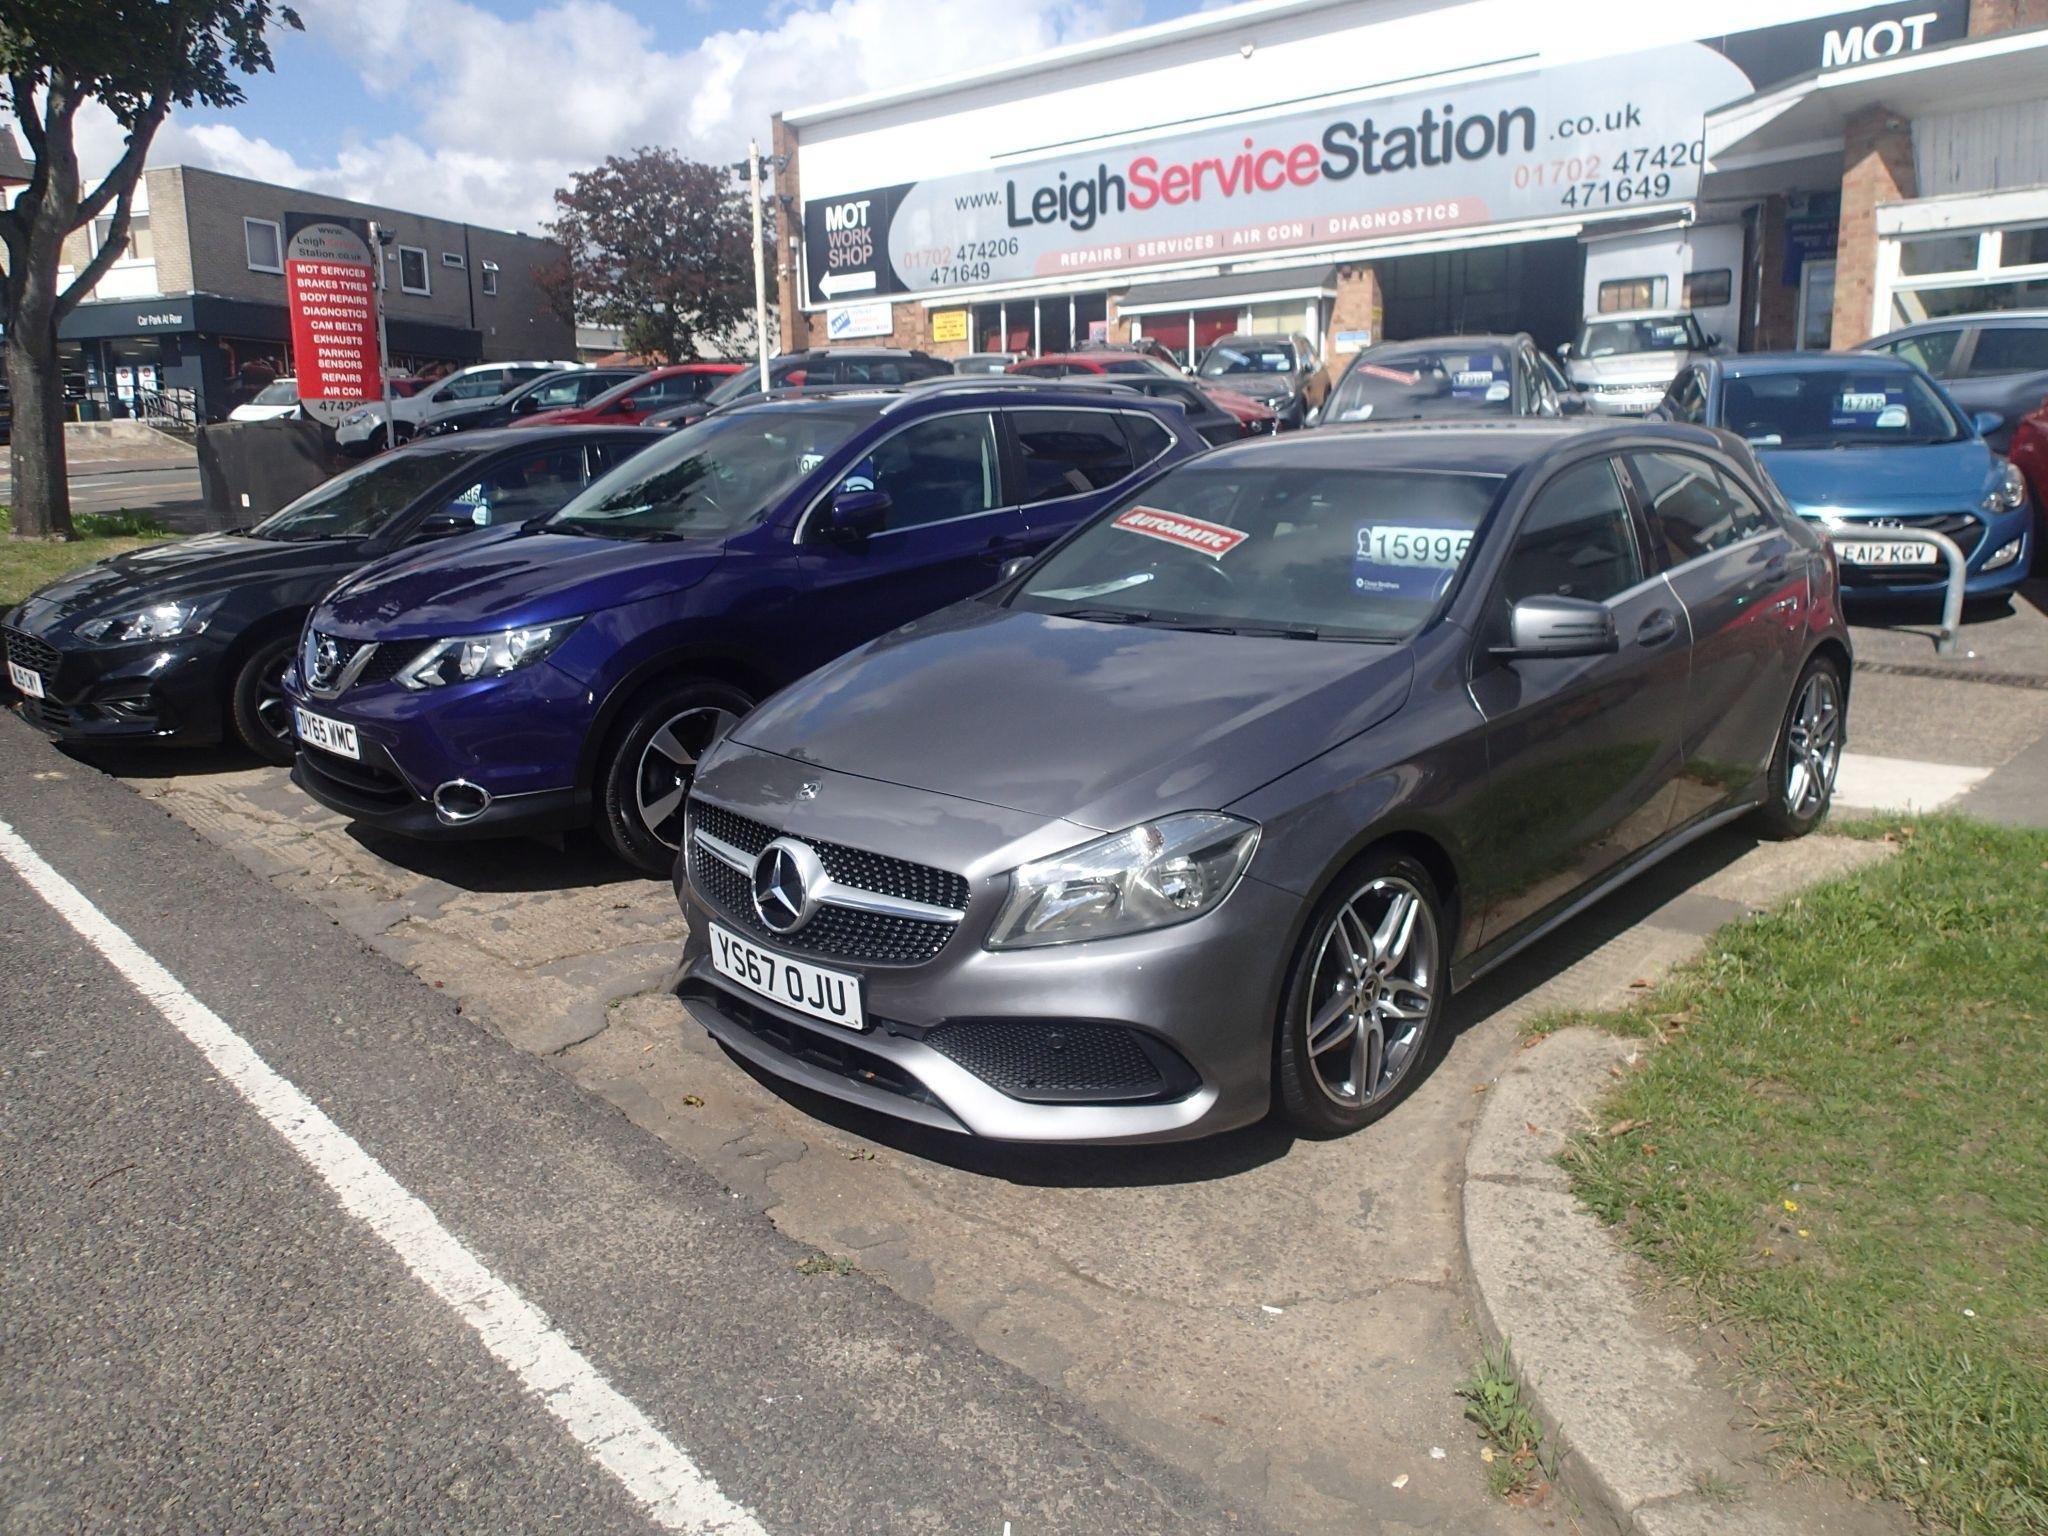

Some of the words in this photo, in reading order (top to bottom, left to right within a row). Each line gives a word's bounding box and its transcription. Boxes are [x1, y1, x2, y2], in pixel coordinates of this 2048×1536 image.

[1822, 12, 1937, 67] MOT
[1514, 155, 1601, 189] 01702
[1561, 173, 1671, 209] 471649
[825, 201, 870, 232] MOT
[828, 227, 872, 248] WORK
[1060, 247, 1122, 267] REPAIRS
[1137, 235, 1214, 257] SERVICES
[1232, 228, 1261, 245] AIR
[1267, 223, 1303, 241] CON
[1328, 203, 1460, 234] DIAGNOSTICS
[829, 245, 873, 268] SHOP
[904, 247, 951, 269] 01702
[957, 238, 1019, 262] 474206
[297, 264, 318, 273] MOT
[321, 265, 365, 278] SERVICES
[931, 262, 990, 284] 471649
[297, 279, 337, 289] BRAKES
[340, 281, 367, 291] TYRES
[300, 292, 327, 302] BODY
[329, 294, 367, 305] REPAIRS
[303, 306, 367, 318] DIAGNOSTICS
[138, 315, 148, 326] Car
[149, 314, 162, 325] Park
[169, 314, 182, 323] Rear
[311, 321, 333, 330] CAM
[335, 322, 362, 331] BELTS
[313, 334, 362, 345] EXHAUSTS
[319, 348, 360, 358] PARKING
[318, 359, 362, 369] SENSORS
[322, 373, 361, 382] REPAIRS
[324, 386, 340, 395] AIR
[342, 387, 362, 396] CON
[319, 401, 367, 411] 4742
[1121, 512, 1231, 548] AUTOMATIC
[1890, 546, 1925, 561] KGV
[299, 711, 327, 743] DY65
[328, 722, 354, 751] WMC
[718, 932, 775, 991] YS67
[785, 965, 846, 1016] OJU
